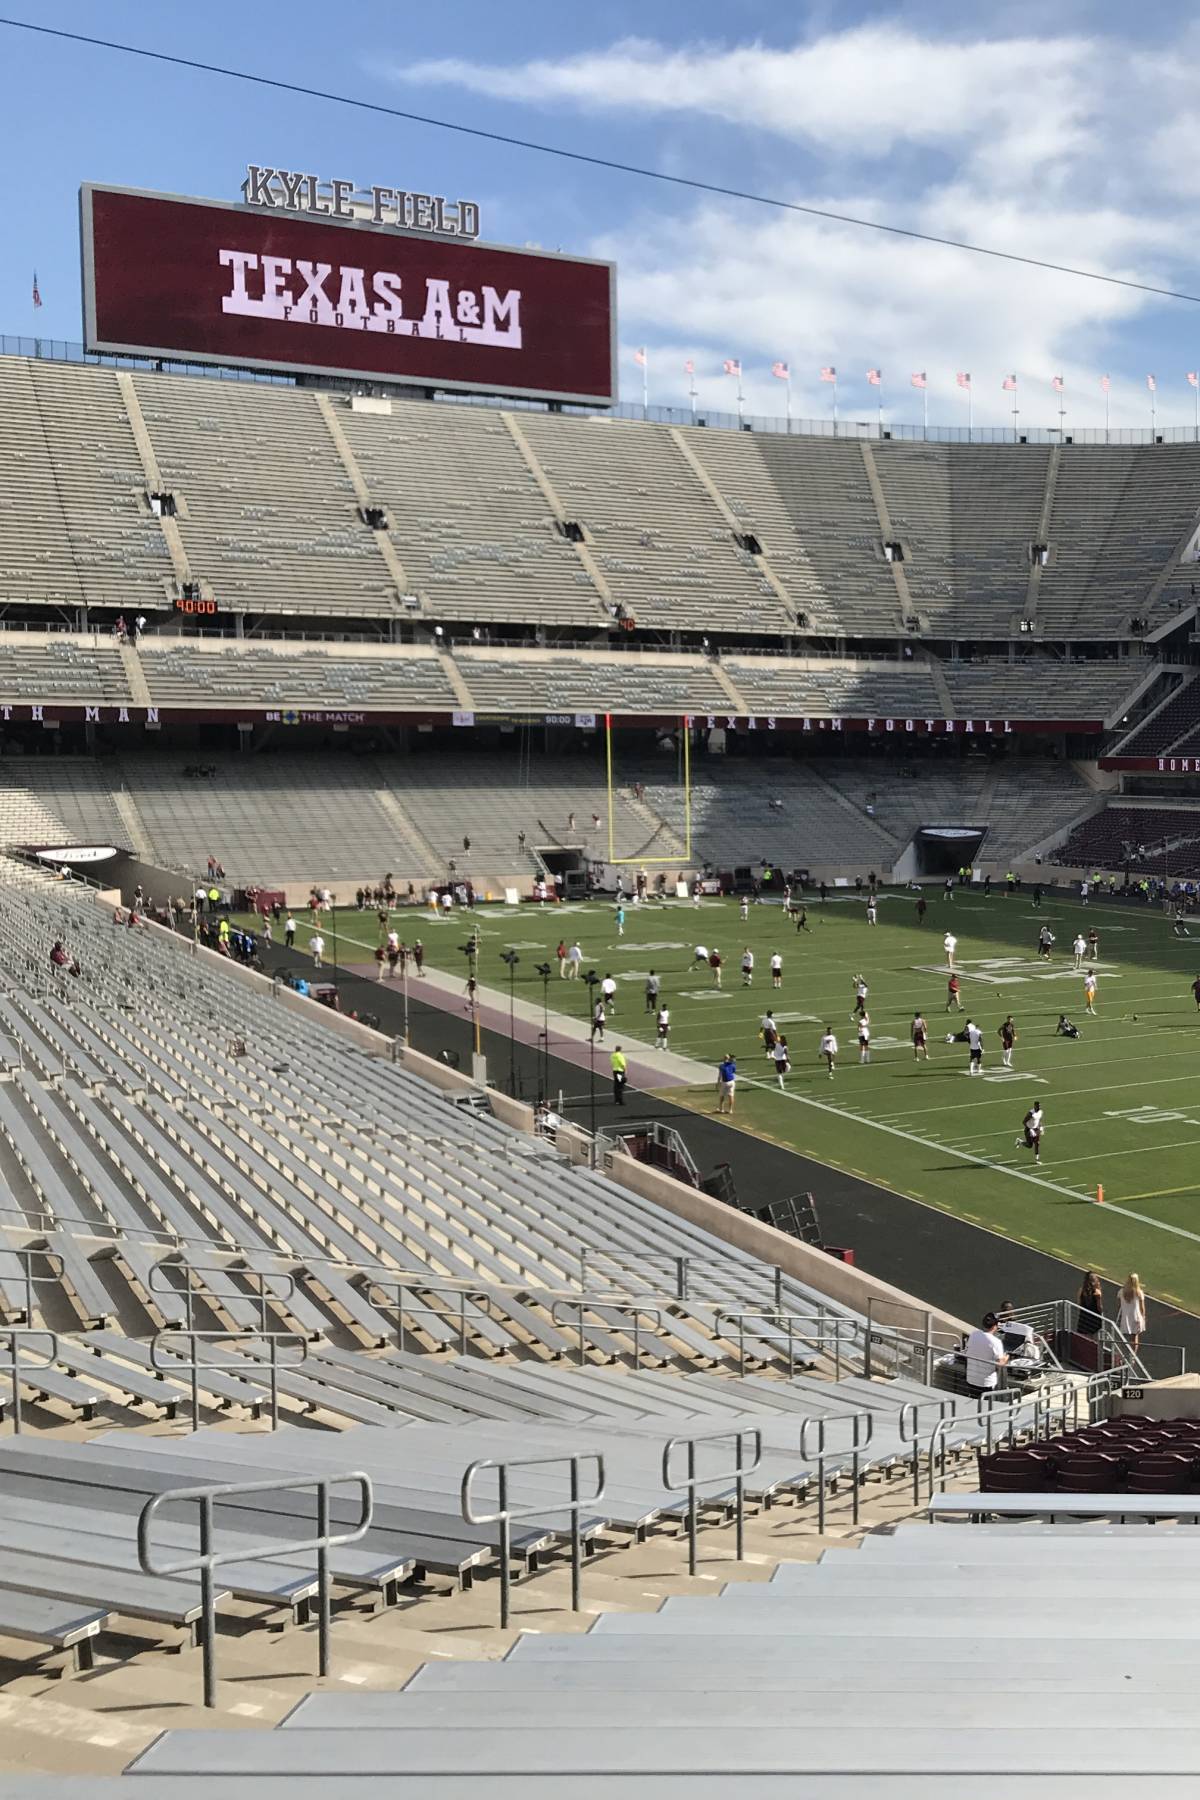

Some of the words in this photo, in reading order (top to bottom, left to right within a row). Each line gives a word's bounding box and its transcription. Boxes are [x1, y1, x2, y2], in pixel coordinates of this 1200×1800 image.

[248, 164, 355, 220] KYLE
[371, 186, 481, 240] FIELD
[219, 249, 402, 321] TEXAS
[422, 278, 522, 342] A&M
[283, 305, 468, 342] FOOTBALL
[1, 705, 44, 721] TH
[85, 706, 159, 722] MAN
[266, 712, 281, 721] BE
[302, 713, 322, 722] THE
[326, 714, 365, 722] MATCH
[688, 716, 776, 730] TEXAS
[803, 718, 842, 731] A&M
[868, 719, 1012, 732] FOOTBALL
[1158, 758, 1200, 772] HOME
[1126, 1390, 1141, 1398] 120
